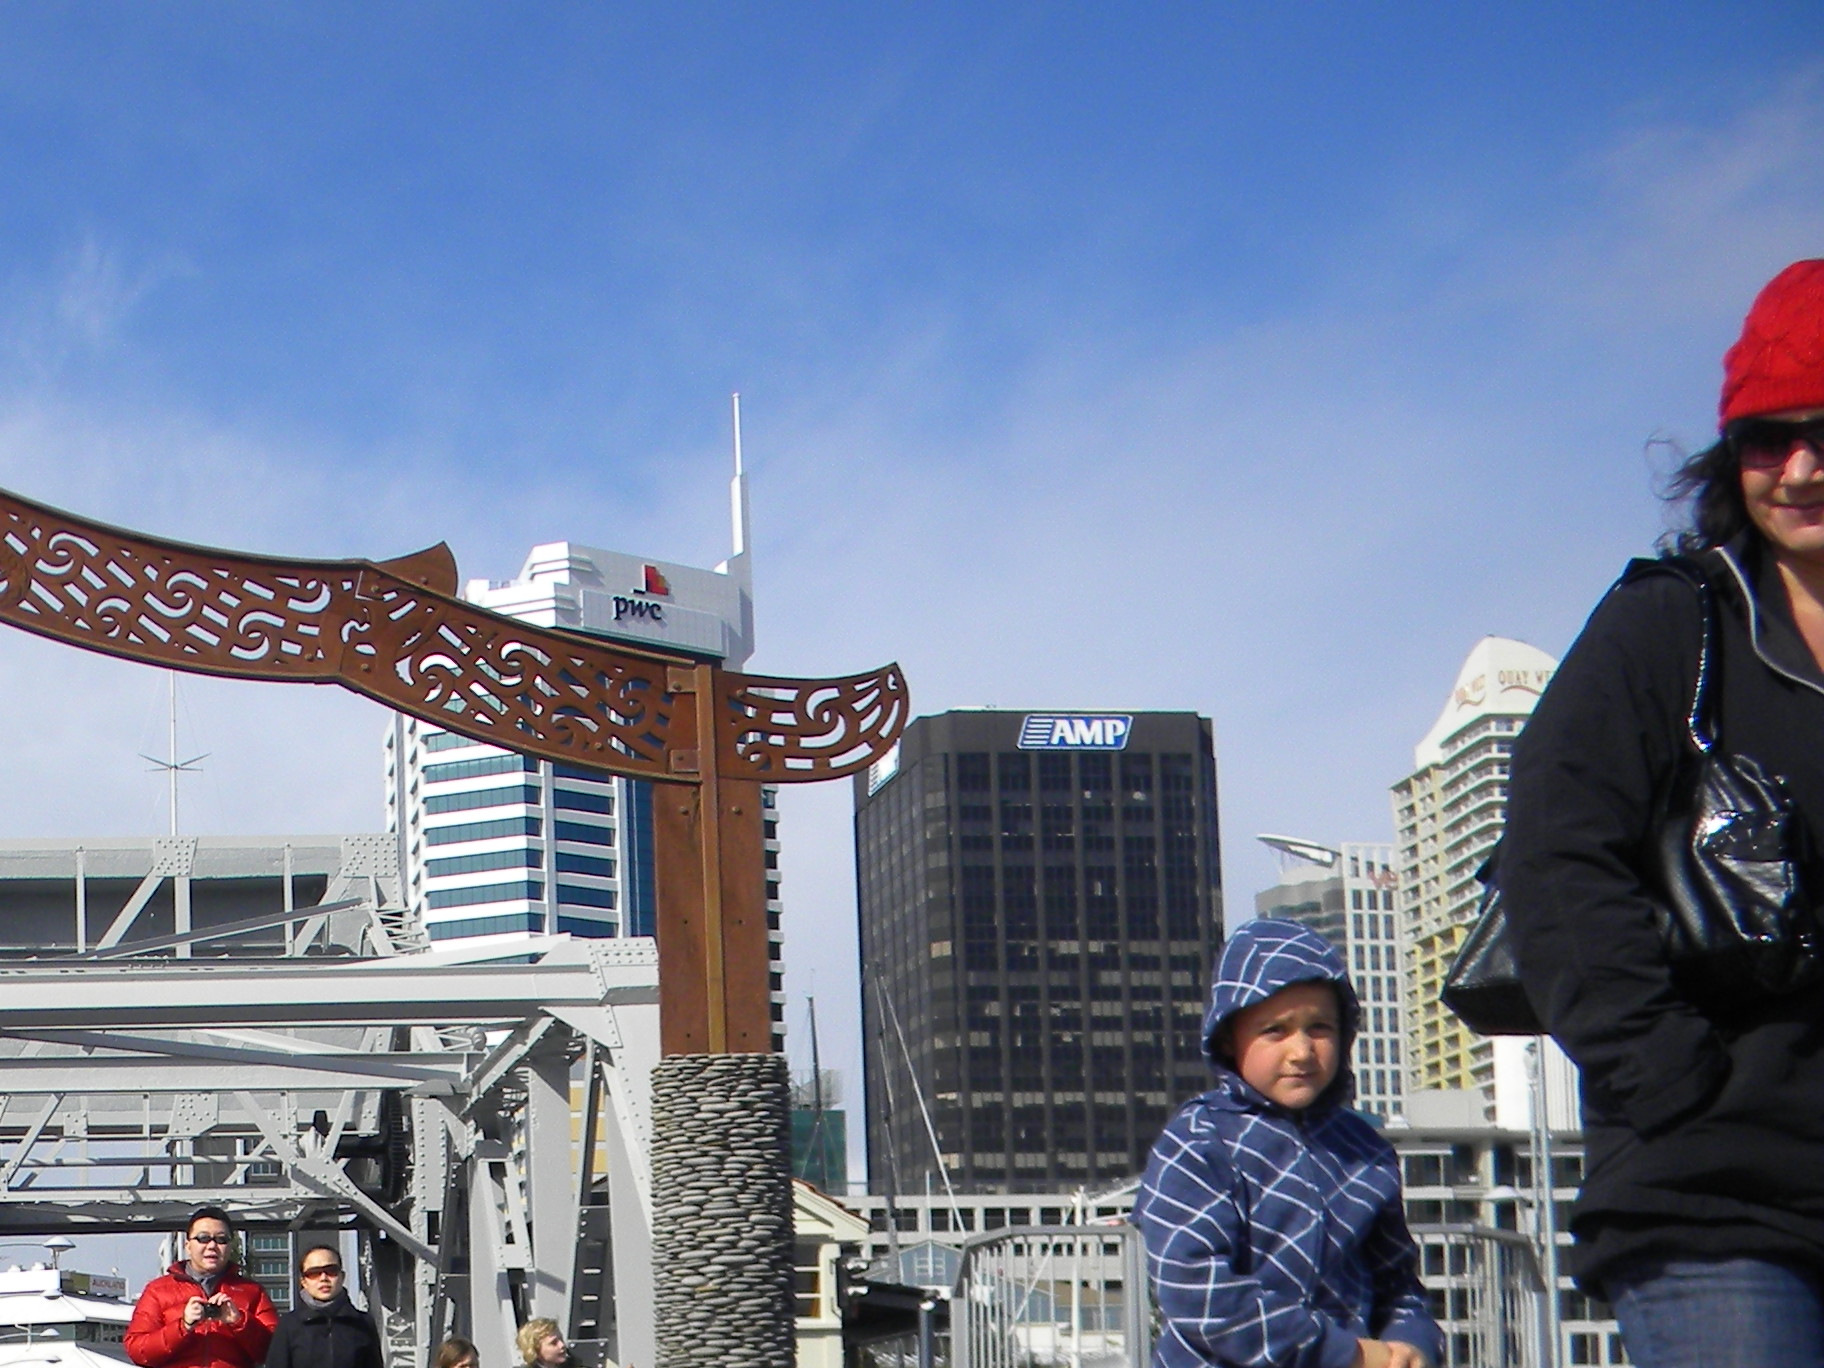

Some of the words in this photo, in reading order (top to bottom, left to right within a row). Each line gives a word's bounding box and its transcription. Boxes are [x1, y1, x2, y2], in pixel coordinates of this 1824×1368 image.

[612, 595, 662, 621] pwc
[1498, 670, 1528, 685] QUAY
[1050, 719, 1127, 746] AMP
